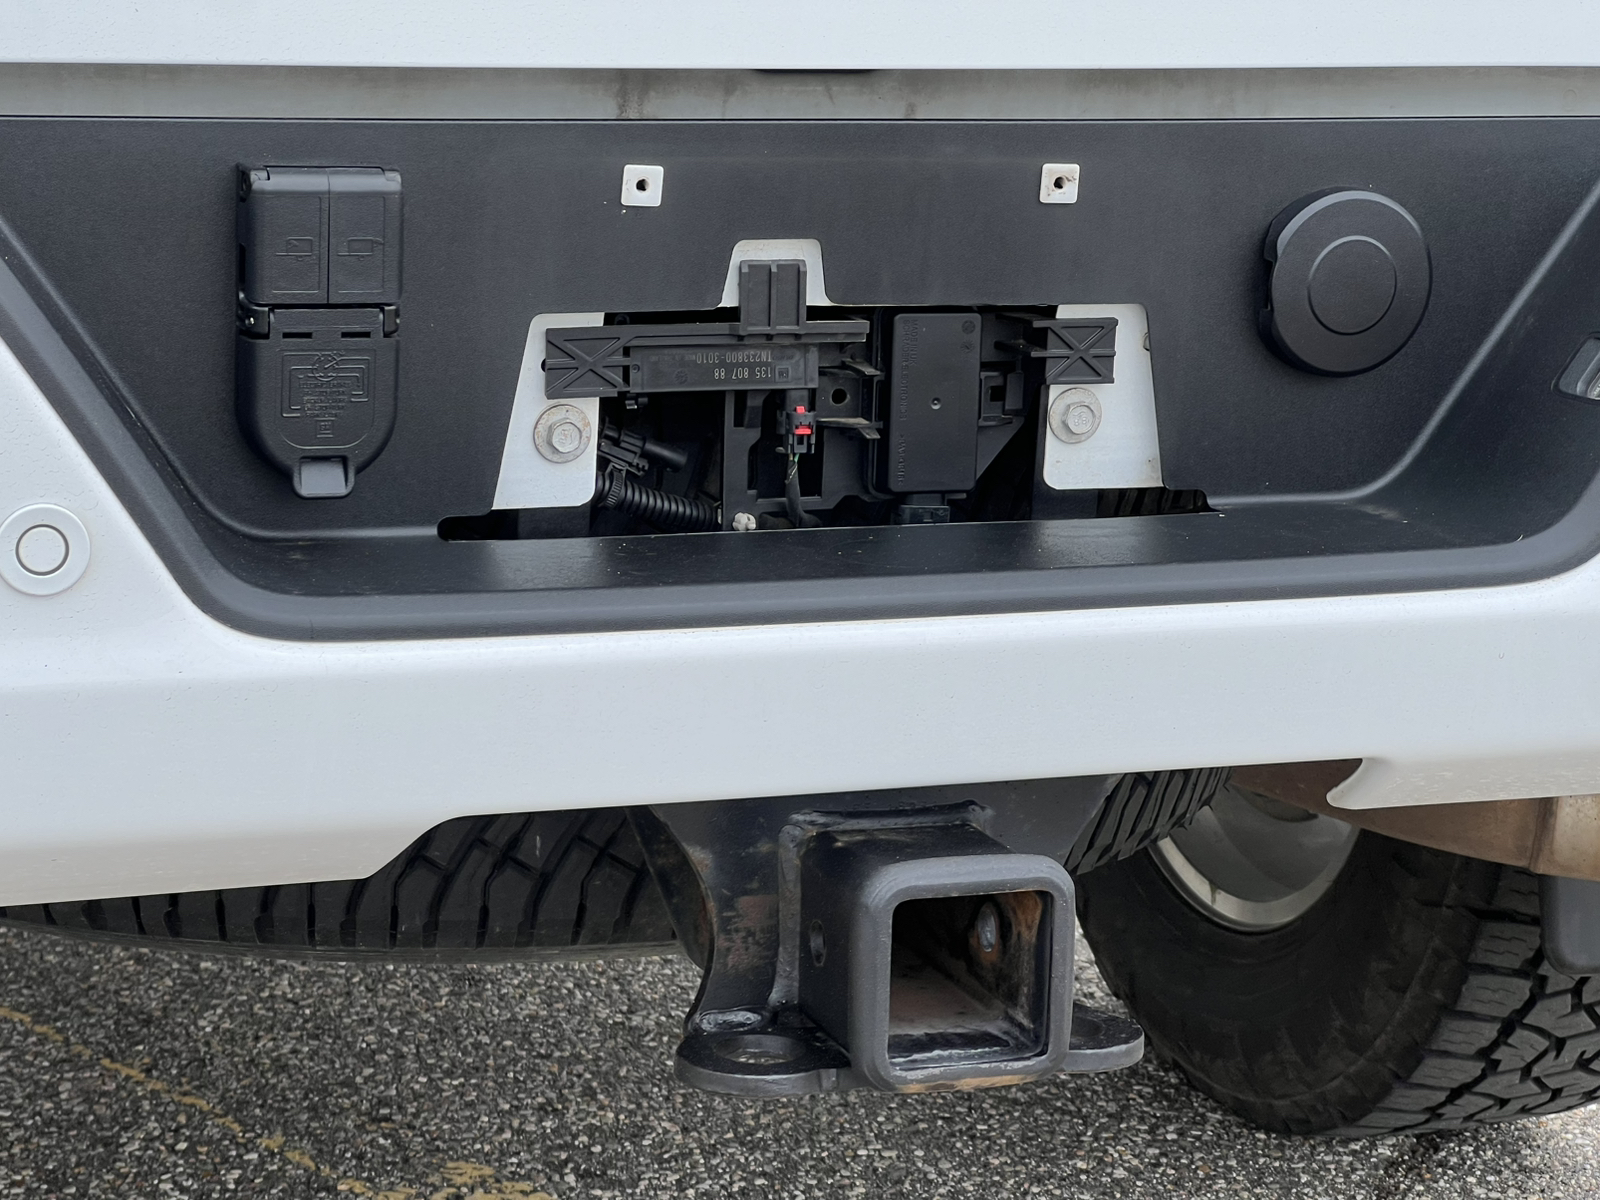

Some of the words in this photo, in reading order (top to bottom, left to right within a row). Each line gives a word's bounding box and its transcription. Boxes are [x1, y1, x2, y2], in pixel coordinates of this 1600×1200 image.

[713, 368, 726, 379] 88
[732, 367, 749, 379] 807
[755, 366, 772, 378] 135
